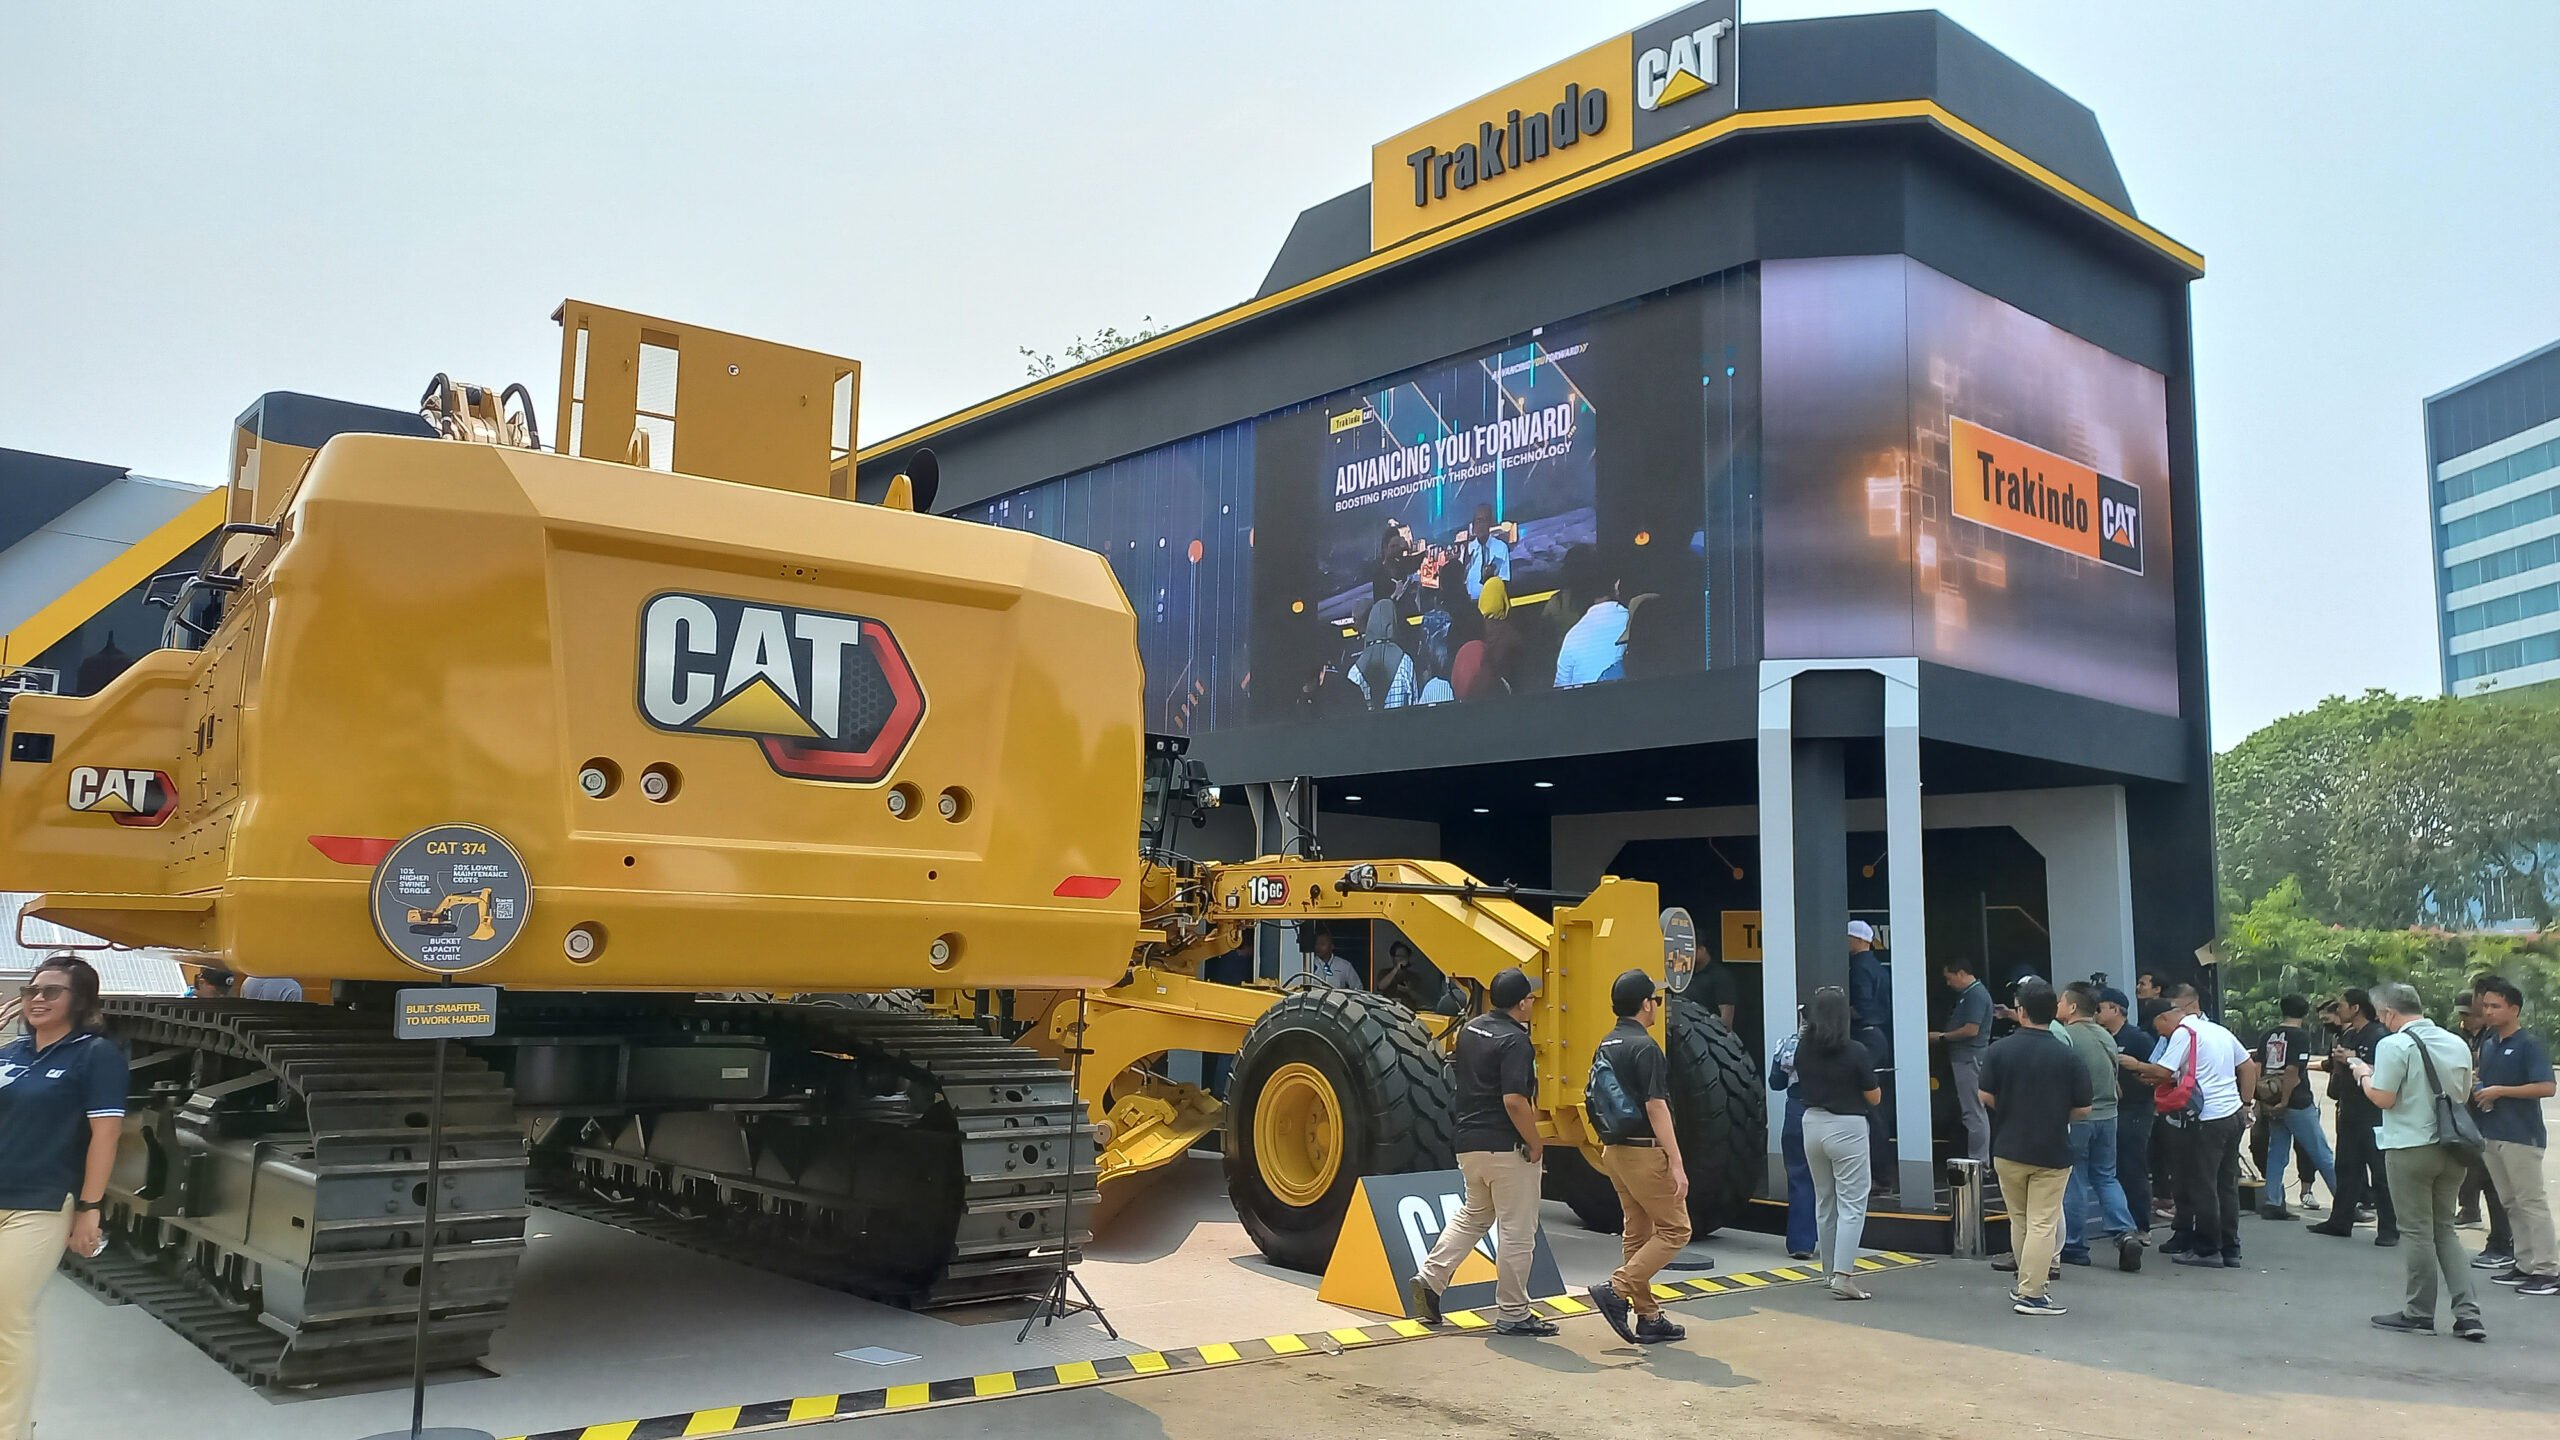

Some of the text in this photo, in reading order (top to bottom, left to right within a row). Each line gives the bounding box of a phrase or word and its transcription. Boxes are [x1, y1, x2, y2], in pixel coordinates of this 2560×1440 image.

[1407, 20, 1731, 207] Trakindo CAT
[1335, 403, 1571, 497] ADVANCING YOU FORWARD
[1335, 441, 1573, 512] BOOSTING PRODUCTIVITY THROUGH TECHNOLOGY
[1977, 450, 2136, 549] Trakindo CAT
[644, 596, 859, 739] CAT
[69, 767, 155, 813] CAT
[426, 842, 487, 855] CAT 374
[453, 864, 470, 872] 20%
[453, 870, 509, 878] MAINTENANCE
[399, 874, 430, 882] HIGHER
[453, 876, 479, 884] COSTS
[406, 1005, 434, 1013] BUILT
[406, 1014, 490, 1025] TO WORK HARDER
